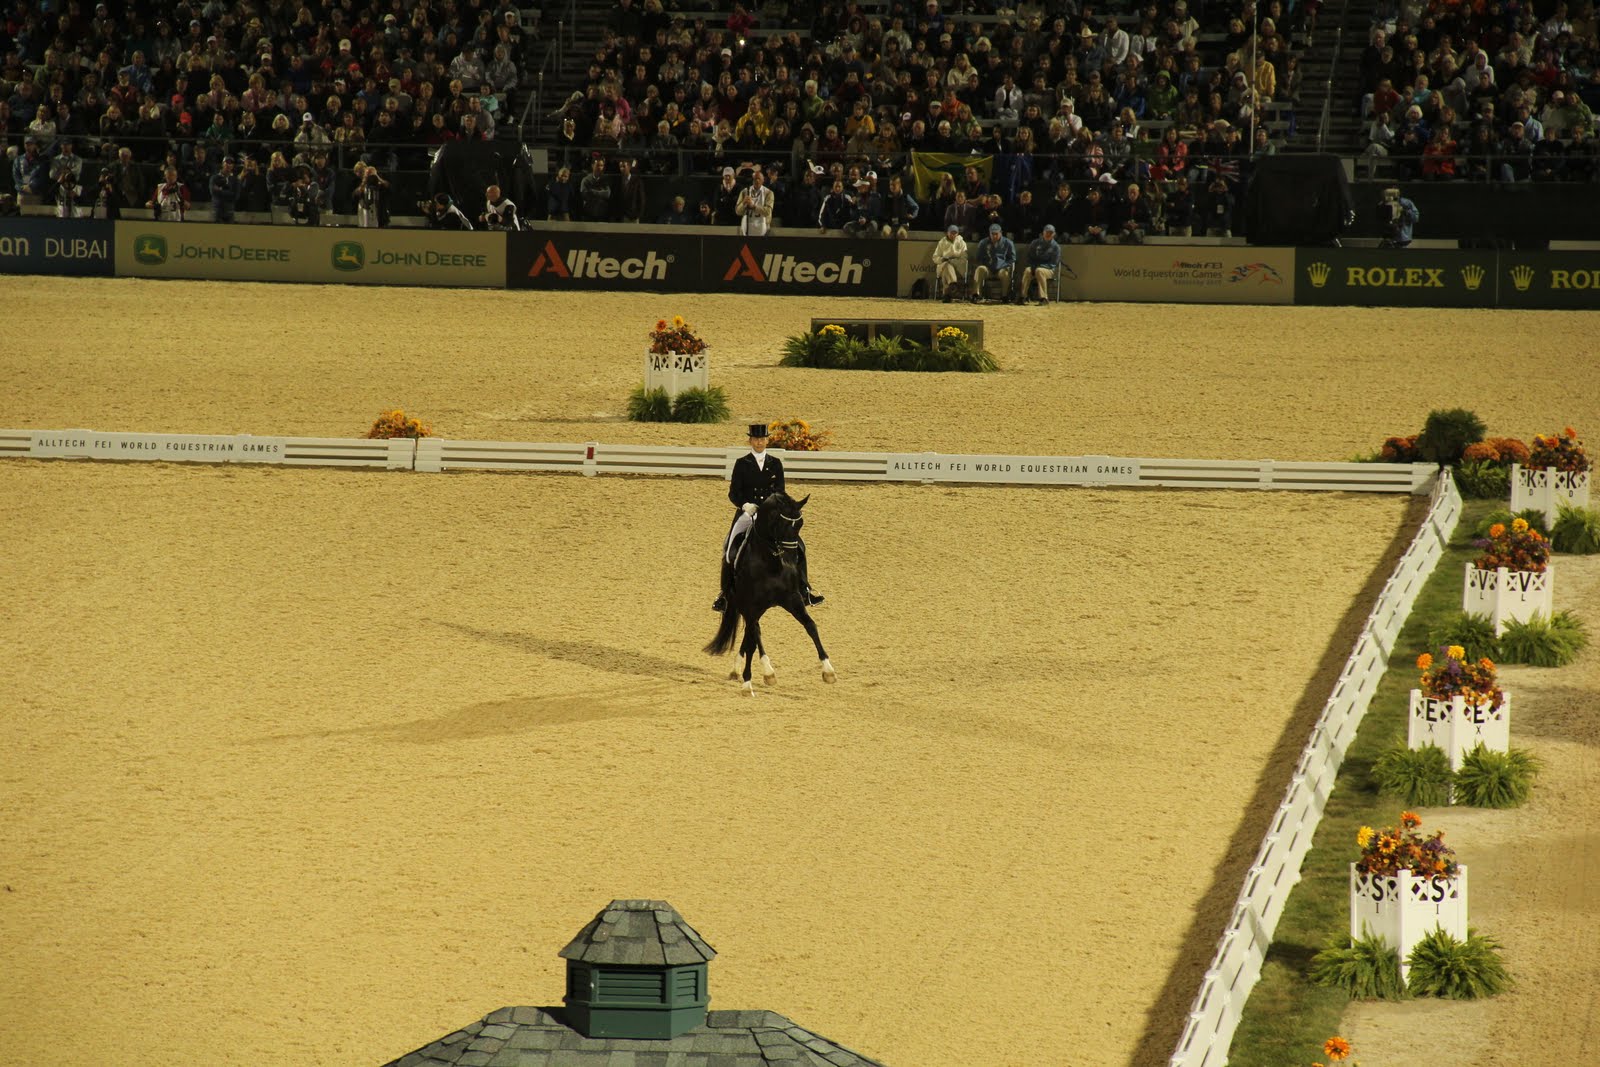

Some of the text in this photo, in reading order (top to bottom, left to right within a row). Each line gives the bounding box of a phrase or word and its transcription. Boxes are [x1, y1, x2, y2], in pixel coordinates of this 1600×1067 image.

[45, 238, 108, 259] DUBAI
[173, 243, 290, 262] JOHN DEERE
[370, 249, 487, 267] JOHN DEERE
[1113, 268, 1223, 280] World Equestrian Games
[1346, 267, 1445, 288] ROLEX
[653, 355, 661, 372] A
[683, 357, 693, 373] A
[38, 439, 280, 453] ALLTECH FEI WORLD EQUESTRIAN GAMES
[894, 462, 1134, 475] ALLTECH FEI WORLD EQUESTRIAN GAMES
[1527, 470, 1537, 488] K
[1566, 470, 1577, 489] K
[1478, 570, 1489, 591] V
[1519, 572, 1532, 592] V
[1426, 698, 1438, 722] E
[1473, 701, 1485, 724] E
[1428, 723, 1434, 733] X
[1476, 725, 1481, 735] X
[1371, 874, 1384, 902] S
[1431, 875, 1445, 903] S
